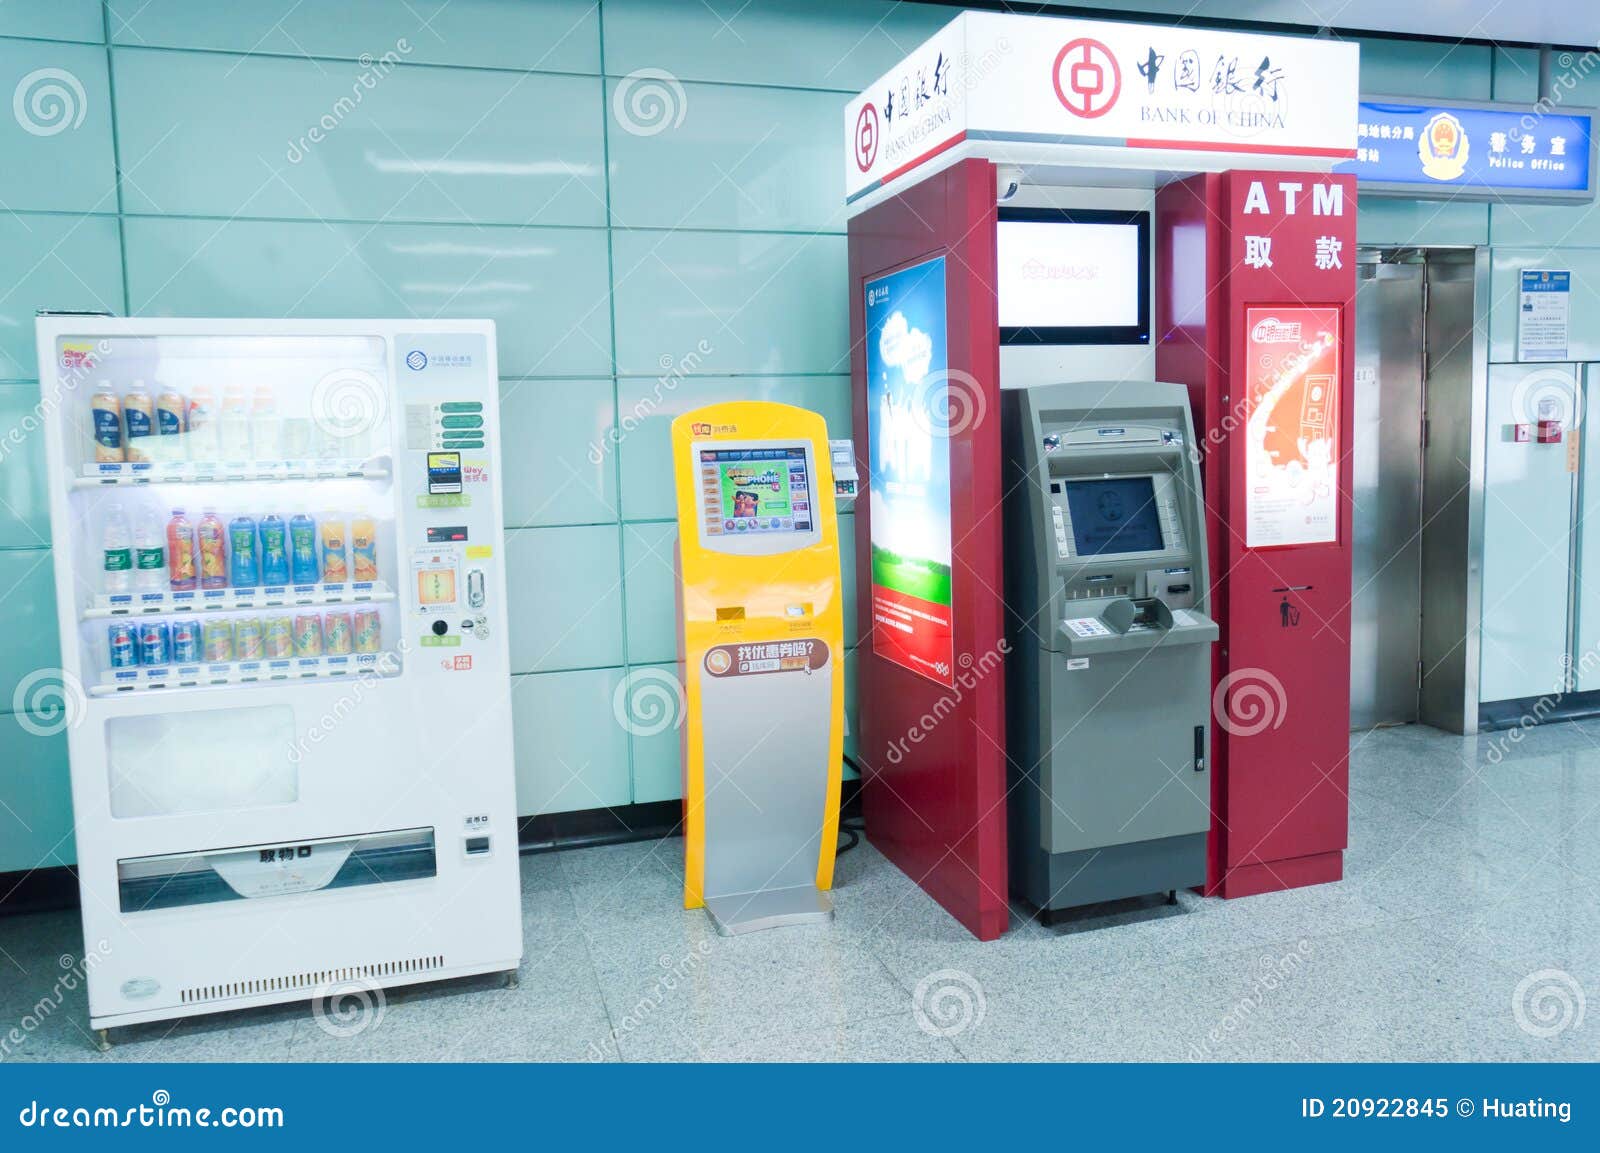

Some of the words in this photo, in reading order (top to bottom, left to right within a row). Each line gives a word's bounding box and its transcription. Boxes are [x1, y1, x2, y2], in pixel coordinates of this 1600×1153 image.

[1140, 105, 1191, 124] BANK
[1197, 108, 1217, 125] OF
[1227, 110, 1285, 129] CHINA
[1489, 131, 1566, 156] 警务室
[1488, 156, 1524, 169] Police
[1530, 158, 1565, 171] Office
[1243, 181, 1343, 216] ATM
[259, 845, 312, 863] 取物口
